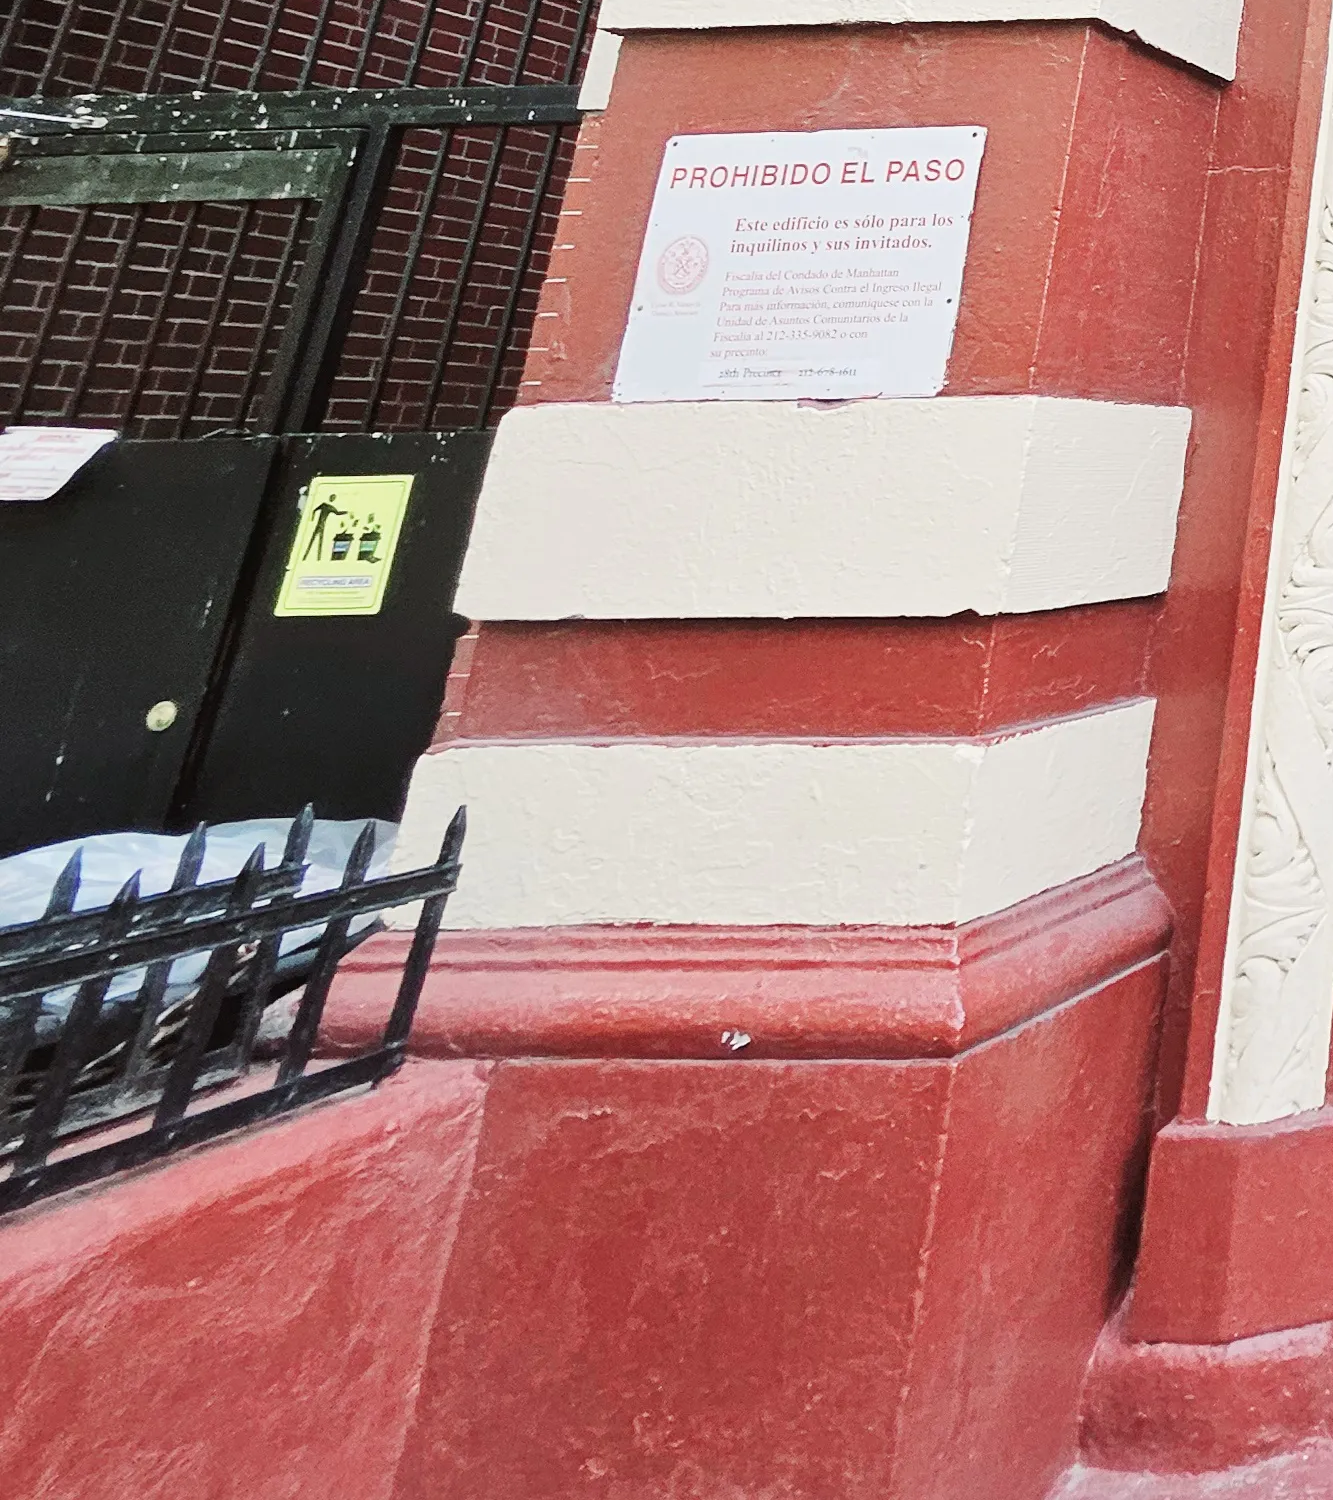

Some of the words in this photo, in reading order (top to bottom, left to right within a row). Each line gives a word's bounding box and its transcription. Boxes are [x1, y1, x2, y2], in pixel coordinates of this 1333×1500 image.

[670, 162, 831, 189] PROHIBIDO
[840, 161, 875, 184] EL
[885, 158, 965, 183] PASO
[735, 218, 768, 232] Este
[772, 216, 829, 231] edificio
[834, 219, 849, 230] es
[853, 215, 885, 229] sólo
[889, 216, 926, 232] para
[931, 213, 954, 227] los
[730, 238, 808, 257] inquilinos
[811, 241, 822, 255] y
[825, 239, 851, 251] sus
[855, 234, 933, 250] invitados.
[765, 270, 782, 281] del
[784, 269, 829, 280] Condado
[830, 269, 843, 279] de
[846, 268, 900, 279] Manhattan
[721, 286, 770, 299] Programa
[772, 285, 785, 295] de
[788, 285, 820, 295] Avisos
[823, 284, 857, 294] Contra
[860, 283, 870, 293] el
[872, 282, 910, 295] Ingreso
[719, 301, 742, 312] Para
[902, 299, 921, 308] con
[923, 296, 934, 307] la
[716, 316, 753, 327] Unidad
[755, 316, 768, 326] de
[769, 315, 811, 326] Asuntos
[884, 312, 897, 323] de
[899, 312, 909, 322] la
[753, 330, 764, 341] al
[840, 331, 847, 339] o
[849, 331, 868, 339] con
